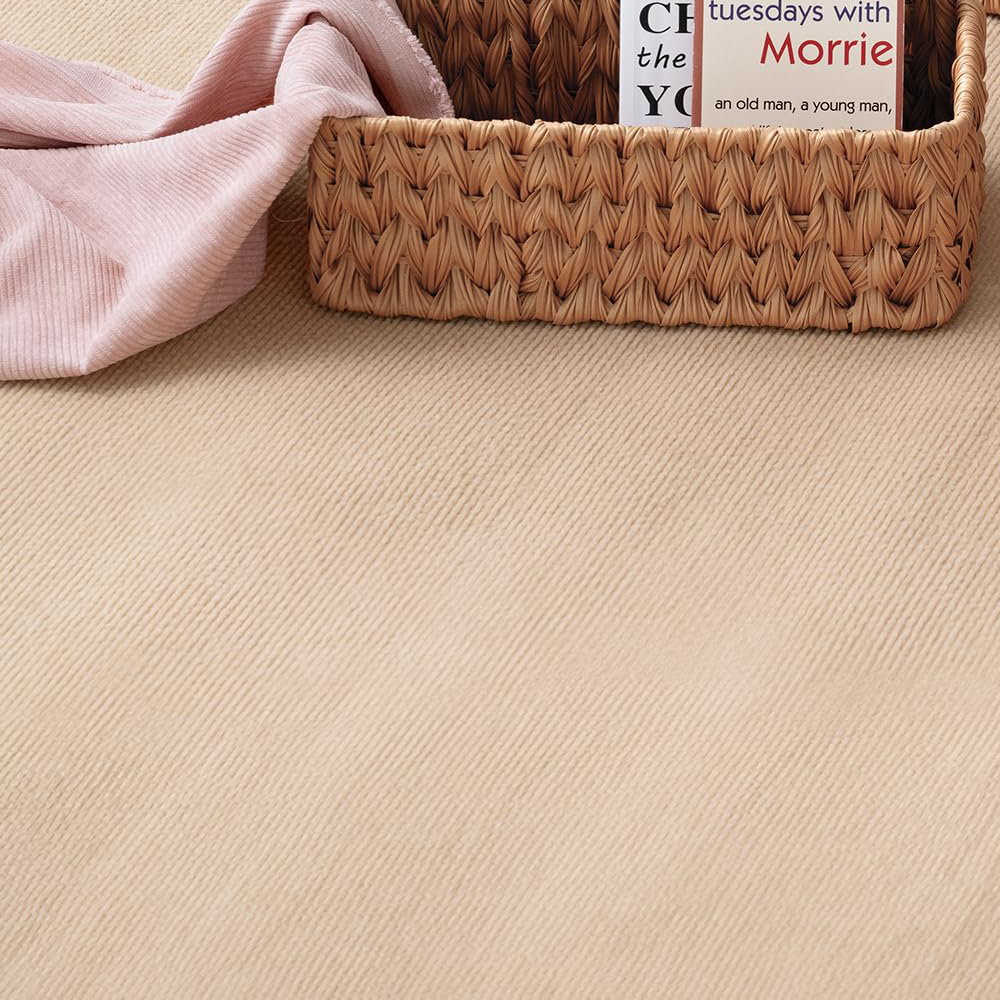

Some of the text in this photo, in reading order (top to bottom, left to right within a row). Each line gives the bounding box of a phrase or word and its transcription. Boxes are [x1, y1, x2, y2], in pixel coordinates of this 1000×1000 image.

[708, 0, 891, 26] tuesdays with
[637, 43, 687, 69] the
[760, 31, 894, 67] Morrie
[715, 97, 892, 115] an old man, a young man,
